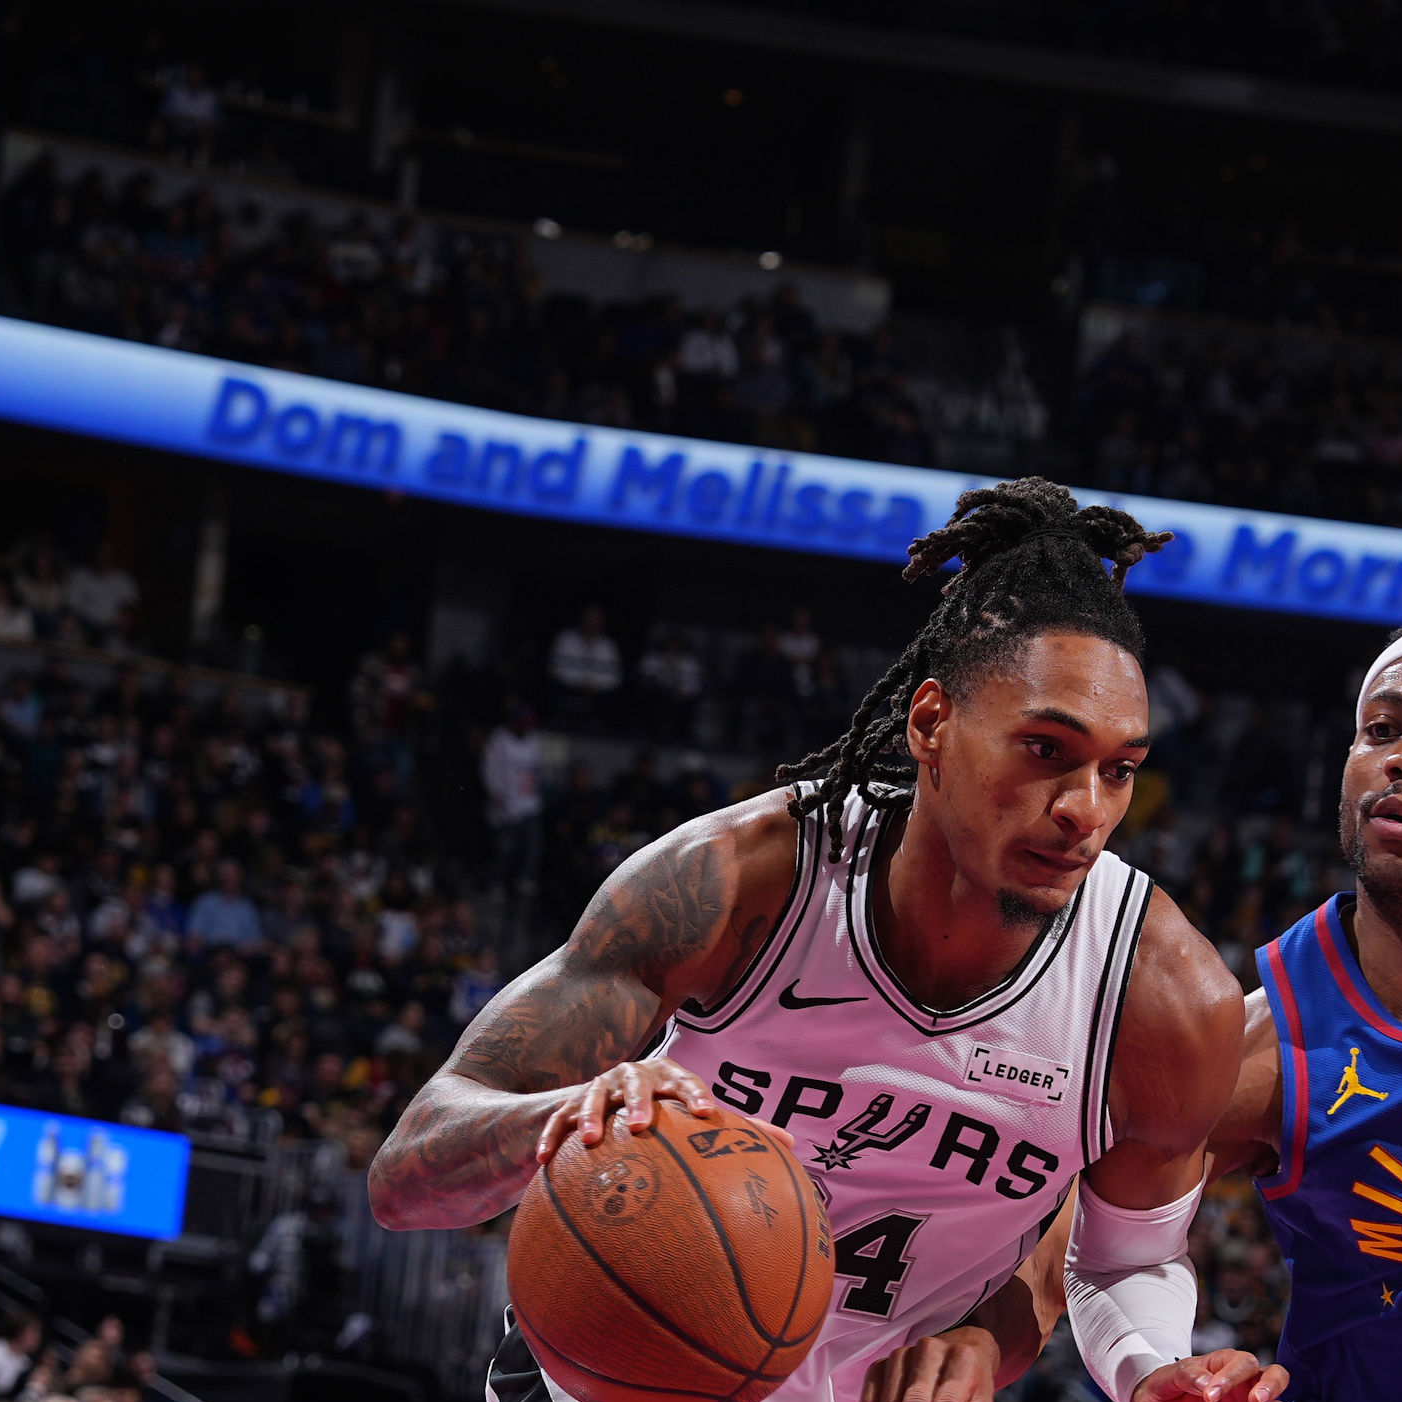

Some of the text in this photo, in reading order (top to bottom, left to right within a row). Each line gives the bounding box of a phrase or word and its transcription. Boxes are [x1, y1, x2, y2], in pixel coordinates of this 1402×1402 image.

[209, 376, 402, 472] Dom
[425, 436, 588, 502] and
[609, 444, 927, 544] Melissa
[712, 1061, 1059, 1199] SPURS
[983, 1060, 1054, 1089] LEDGER
